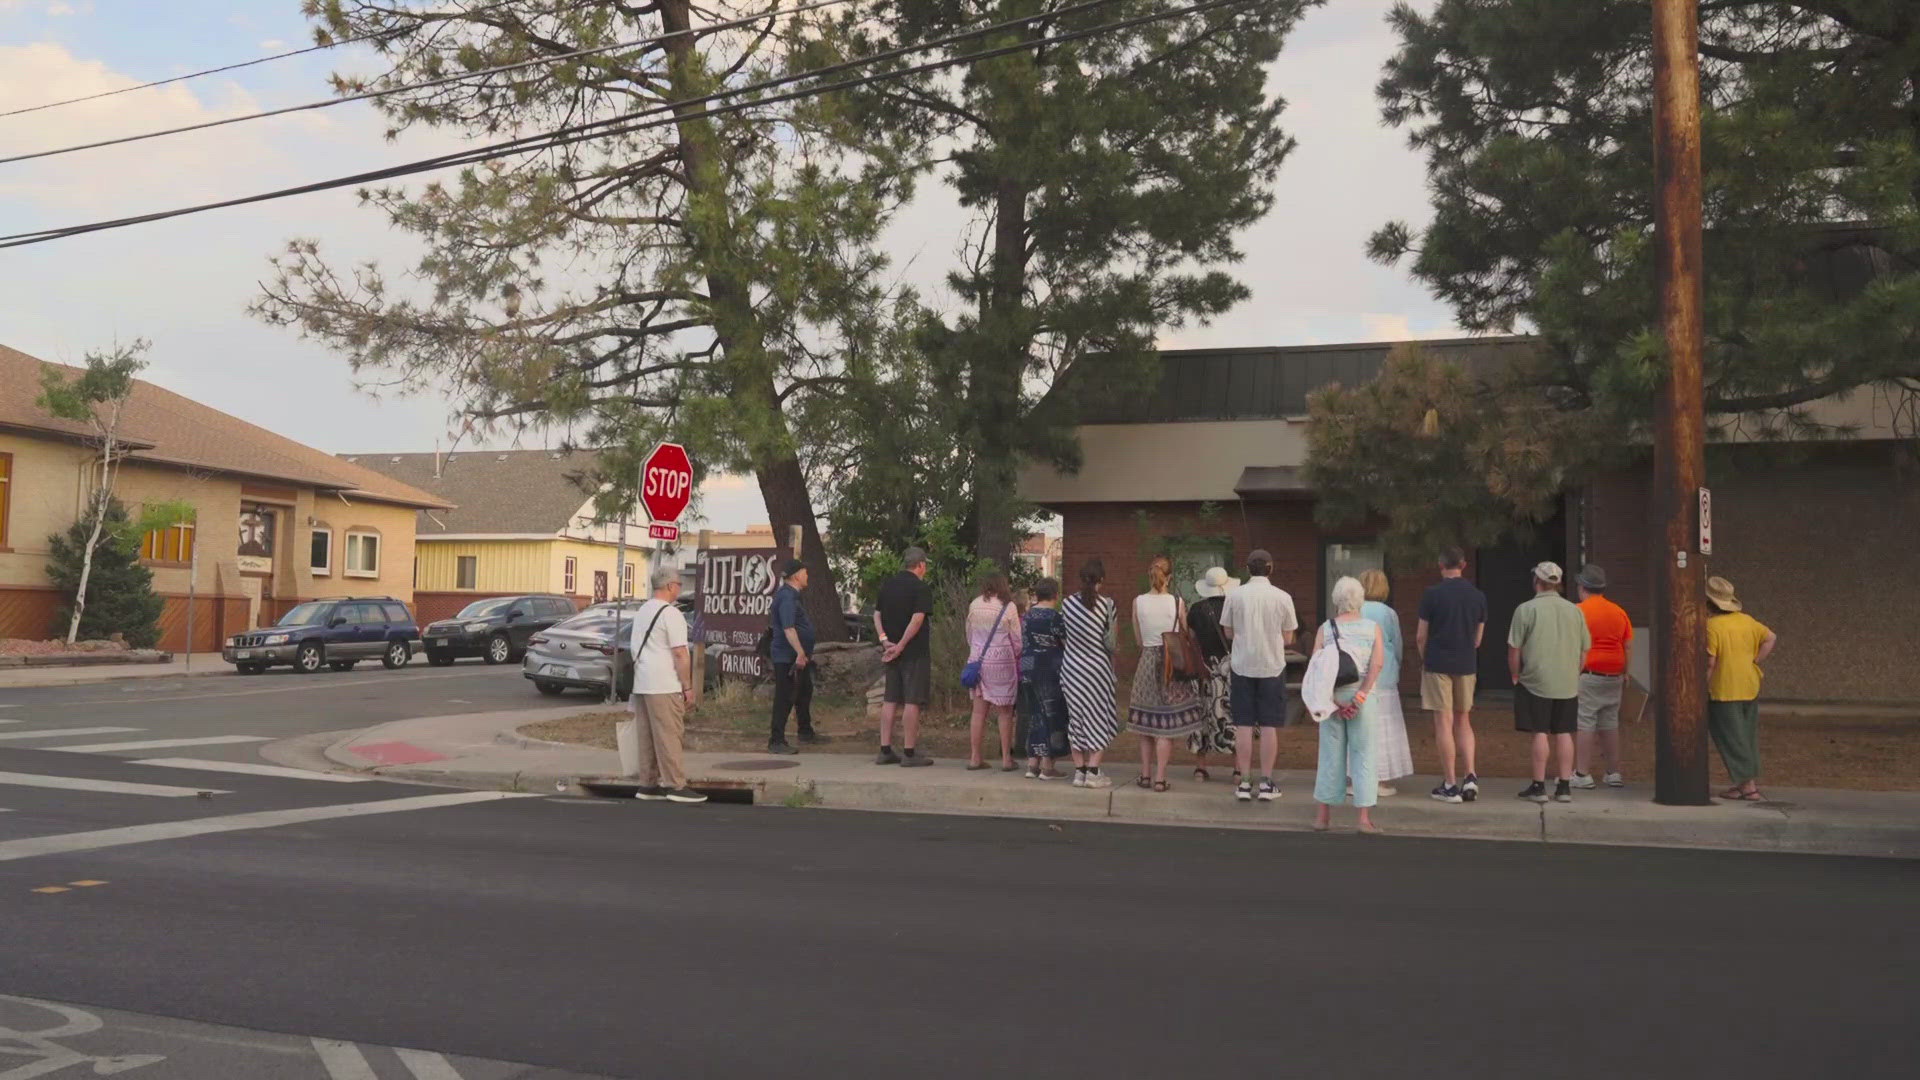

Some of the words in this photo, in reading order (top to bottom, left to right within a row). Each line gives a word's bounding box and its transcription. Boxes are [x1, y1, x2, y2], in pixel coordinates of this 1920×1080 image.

[646, 466, 689, 499] STOP
[651, 527, 661, 537] ALL
[662, 527, 676, 538] WAY
[698, 551, 777, 595] LITHOS
[704, 595, 737, 614] ROCK
[738, 595, 773, 615] SHOP
[732, 630, 754, 645] FOSSILS
[722, 653, 761, 676] PARKING
